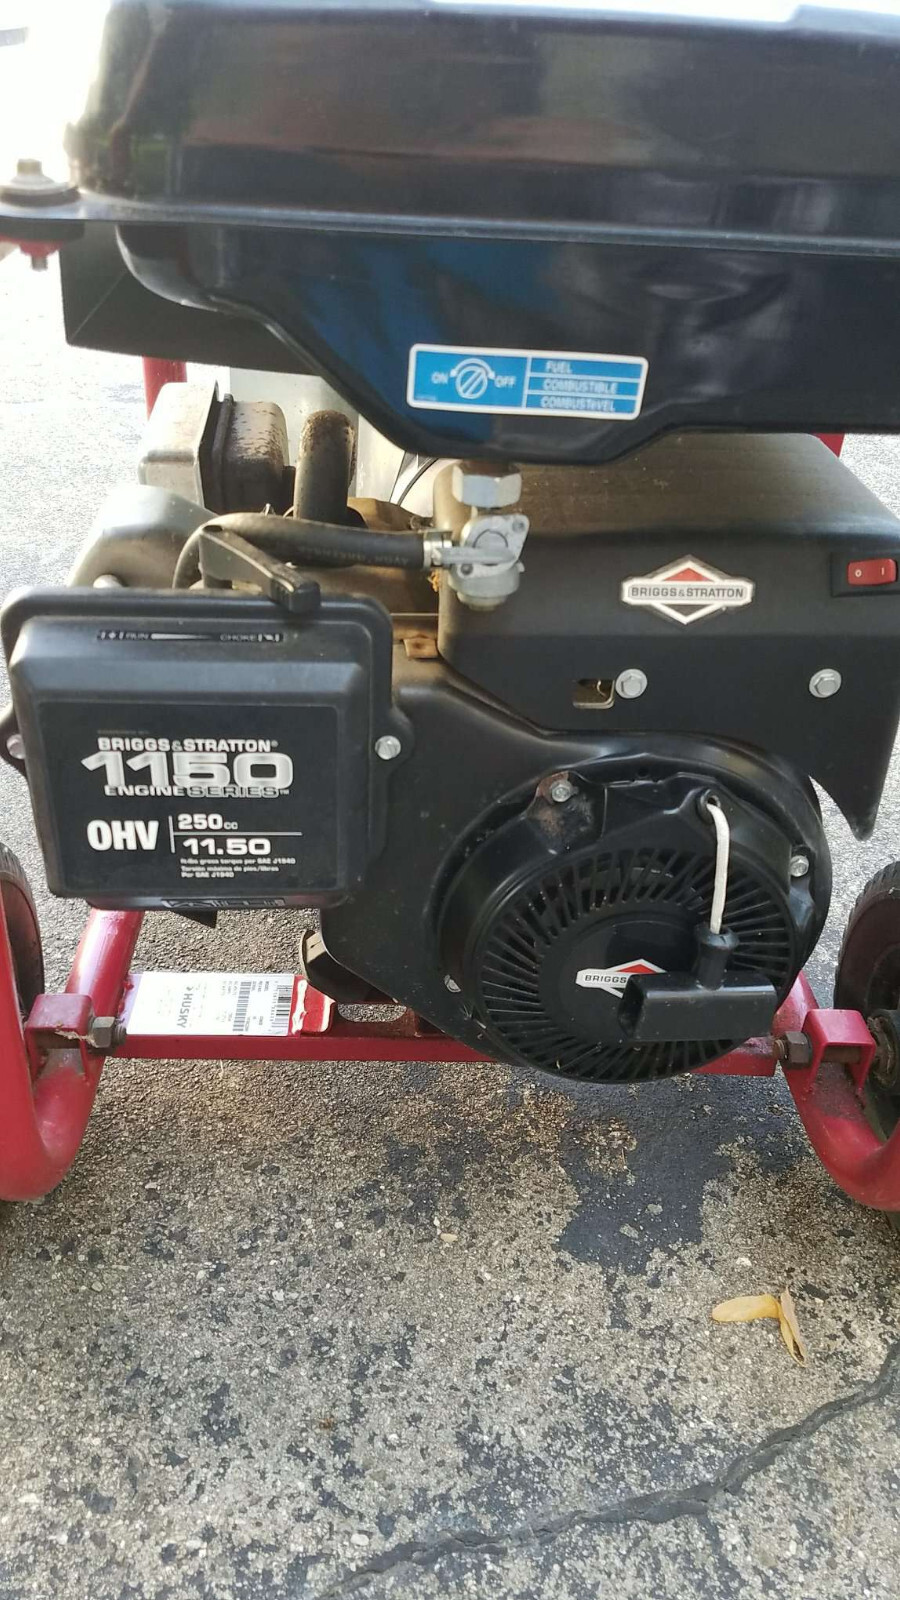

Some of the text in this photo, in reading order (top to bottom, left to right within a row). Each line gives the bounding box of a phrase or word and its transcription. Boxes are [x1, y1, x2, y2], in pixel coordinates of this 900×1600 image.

[545, 360, 573, 374] FUEL
[431, 372, 517, 388] ON OFF
[543, 379, 618, 394] COMBUSTIBLE
[219, 633, 257, 643] CHOKE
[81, 750, 294, 790] 1150
[104, 784, 185, 797] ENGINE
[86, 819, 159, 852] OHV
[182, 837, 272, 856] 11.50
[584, 974, 627, 984] BRIGGS
[176, 992, 194, 1029] HUSKY
